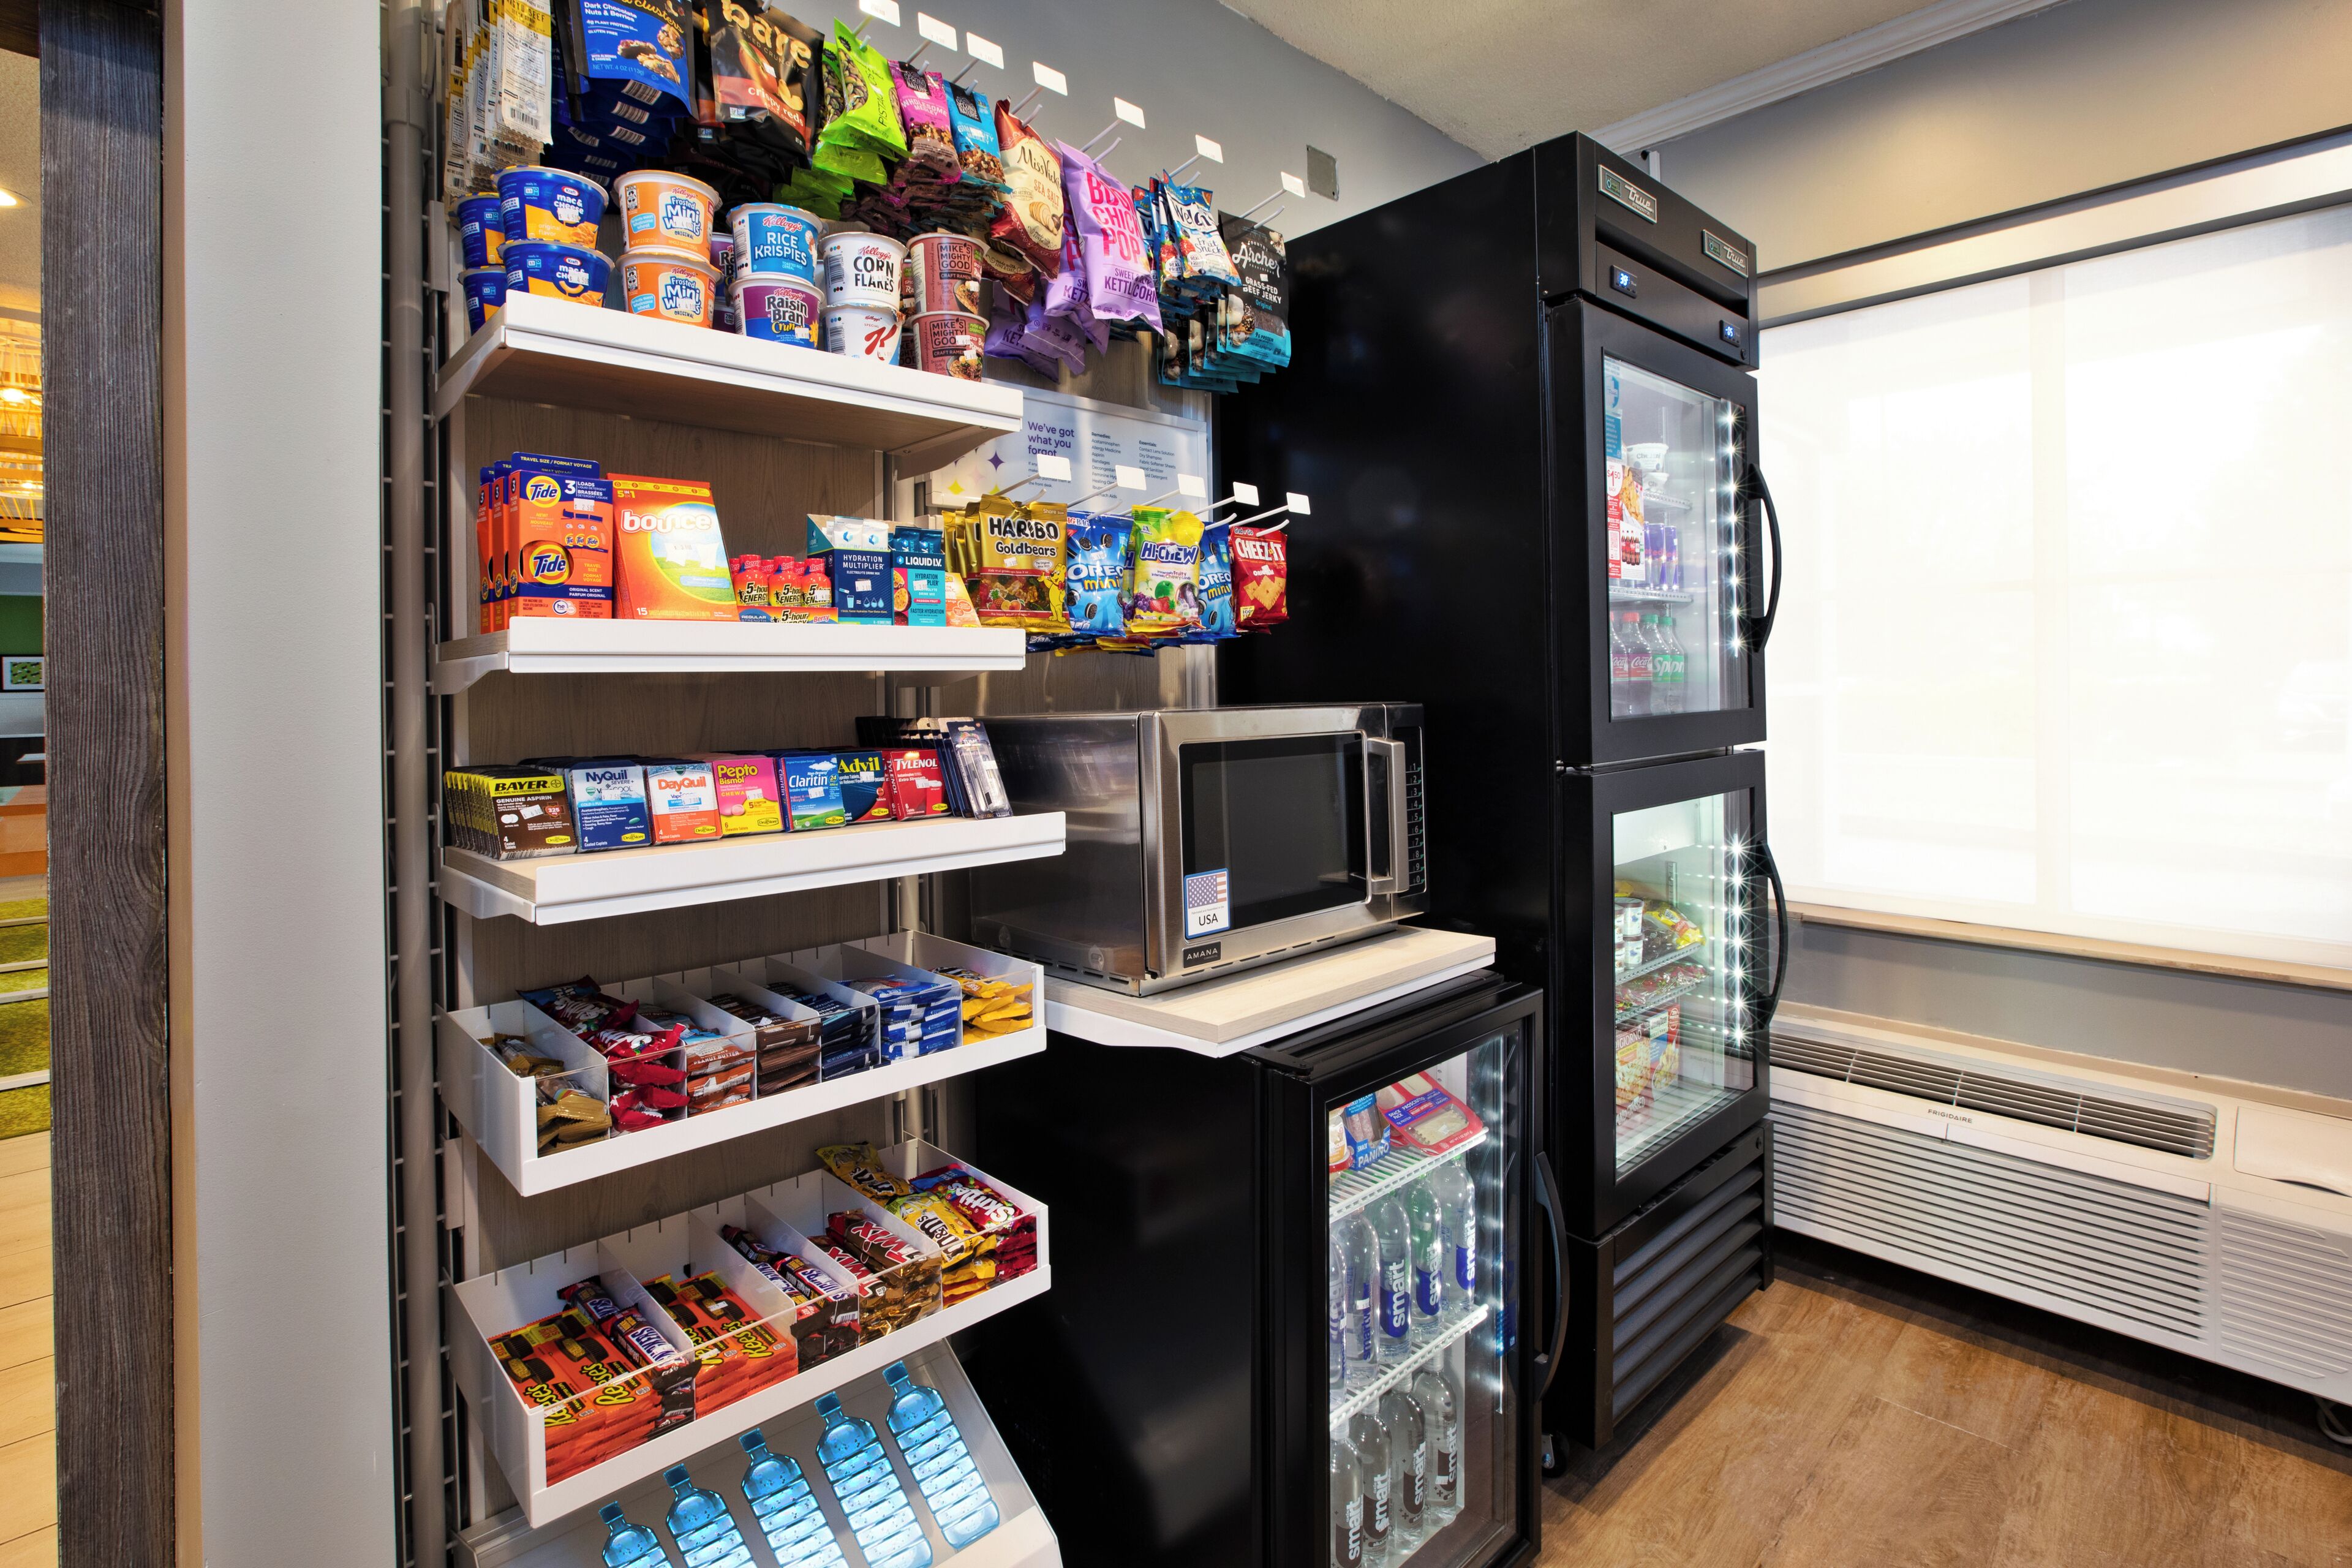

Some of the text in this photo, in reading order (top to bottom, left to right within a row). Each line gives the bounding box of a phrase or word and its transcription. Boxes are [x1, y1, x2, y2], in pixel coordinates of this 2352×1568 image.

[603, 3, 638, 19] Chocolate
[610, 11, 635, 23] Berries
[747, 86, 804, 127] crispy reds
[900, 97, 948, 117] WHOLESOME
[1017, 145, 1044, 175] Miss
[556, 194, 576, 205] mac
[671, 187, 697, 199] Kellogg's
[1034, 179, 1060, 207] SEA SALT
[671, 196, 696, 209] Frosted
[666, 204, 701, 225] Mini
[538, 224, 561, 232] original
[763, 214, 803, 233] Kellogg's
[674, 230, 694, 240] ORIGINAL
[766, 232, 799, 249] RICE
[859, 245, 892, 260] Kellogg's
[940, 243, 971, 255] MIKE'S
[1101, 227, 1141, 265] POP
[755, 245, 807, 267] KRISPIES
[940, 253, 971, 262] MIGHTY
[1232, 241, 1281, 279] Archer
[671, 267, 697, 278] Kellogg's
[854, 256, 894, 279] CORN
[941, 260, 970, 270] GOOD
[671, 276, 696, 289] Frosted
[1115, 268, 1134, 281] SWEET
[666, 284, 701, 303] Mini
[1134, 283, 1158, 304] CORN
[1245, 276, 1278, 295] GRASS-FED
[774, 287, 804, 301] Kellogg's
[1262, 288, 1282, 305] JERKY
[766, 295, 809, 317] Raisin
[1255, 298, 1273, 311] Original
[674, 311, 695, 319] ORIGINAL
[771, 308, 805, 327] Bran
[932, 318, 964, 331] MIKE'S
[1028, 421, 1075, 438] We've got
[1028, 434, 1071, 448] what you
[1091, 439, 1120, 447] Acetaminophen
[529, 483, 558, 501] Tide
[564, 480, 576, 494] 3
[621, 510, 712, 534] bounce
[989, 517, 1060, 541] HARIBO
[1076, 518, 1090, 527] BAG
[995, 541, 1057, 557] Goldbears
[532, 554, 567, 578] Tide
[905, 556, 933, 566] LIQUID
[1068, 564, 1124, 581] OREO
[1199, 571, 1231, 590] OREO
[636, 607, 648, 616] 15
[813, 614, 830, 623] Berry
[717, 763, 758, 780] Pepto
[838, 756, 881, 774] Advil
[894, 758, 938, 771] TYLENOL
[586, 769, 628, 784] NyQuil
[657, 776, 707, 792] DayQuil
[718, 777, 745, 785] Bismol
[789, 774, 827, 788] Claritin
[494, 780, 549, 792] BAYER
[1199, 913, 1218, 926] USA
[1186, 948, 1218, 960] AMANA
[693, 1050, 740, 1065] PEANUT BUTTER
[1401, 1096, 1426, 1110] PROSCIUTTO
[1388, 1109, 1401, 1118] SNACK
[1928, 1108, 1973, 1125] FRIGIDAIRE
[1357, 1143, 1390, 1168] PANINO
[851, 1220, 910, 1265] TWIX
[1389, 1258, 1406, 1329] smart
[1447, 1424, 1457, 1483] smart
[1414, 1448, 1425, 1506] smart
[1346, 1496, 1361, 1561] smart
